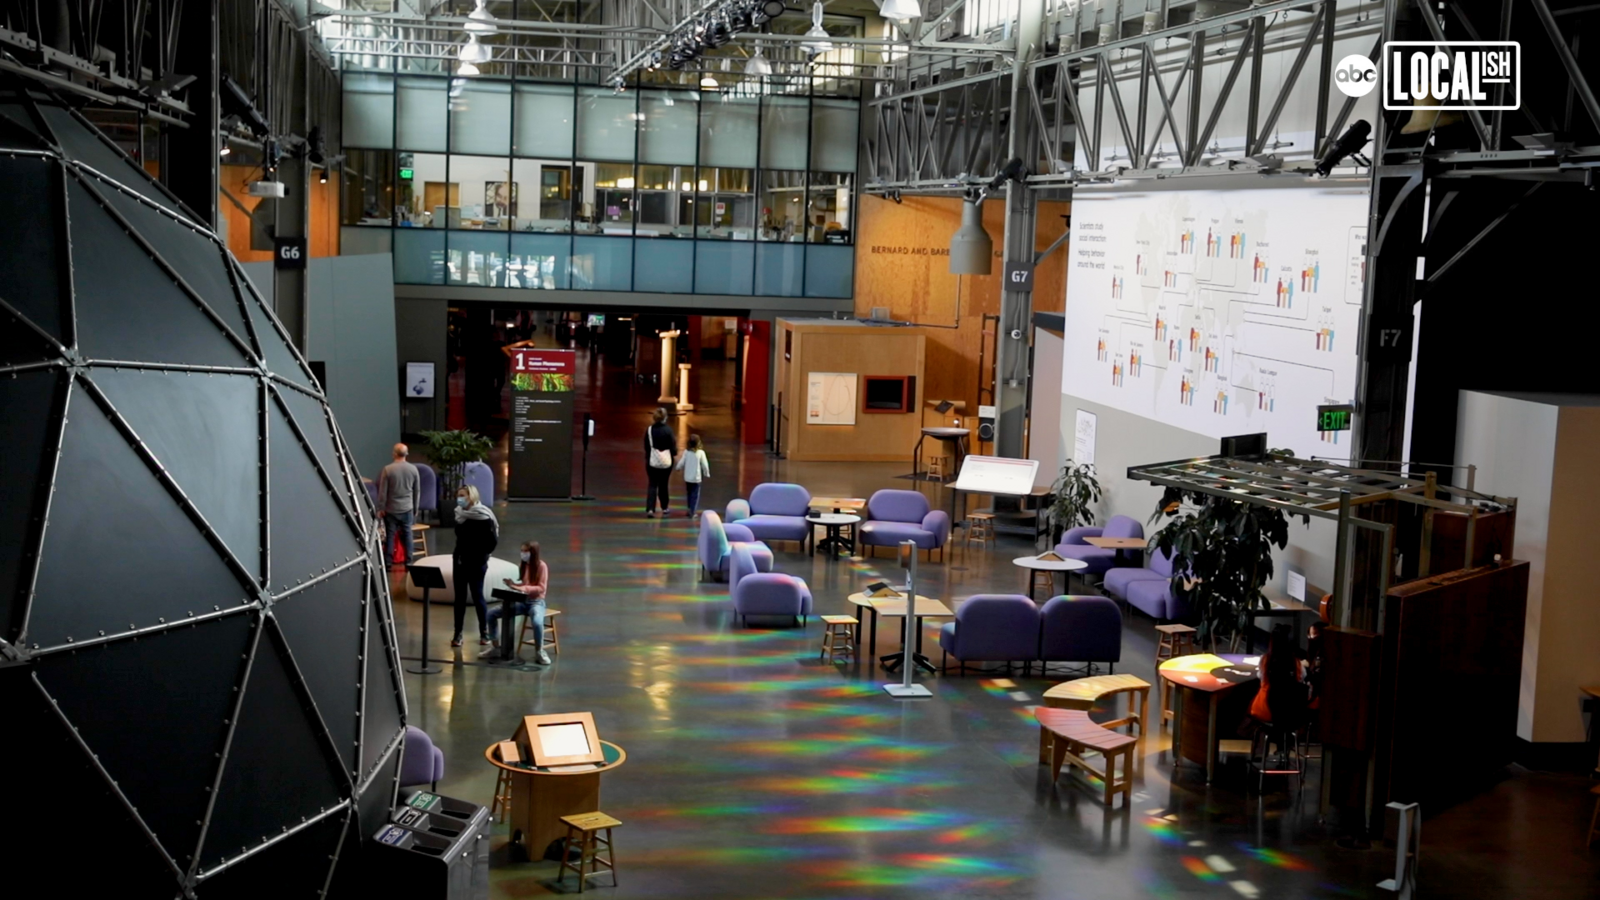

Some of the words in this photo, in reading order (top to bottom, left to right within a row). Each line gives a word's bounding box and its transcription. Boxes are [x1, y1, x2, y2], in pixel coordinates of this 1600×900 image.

[280, 246, 300, 259] G6
[871, 246, 909, 255] BERNARD
[911, 247, 928, 256] AND
[1011, 270, 1029, 283] G7
[1380, 329, 1402, 347] F7
[515, 352, 526, 370] 1
[1323, 411, 1346, 430] EXIT
